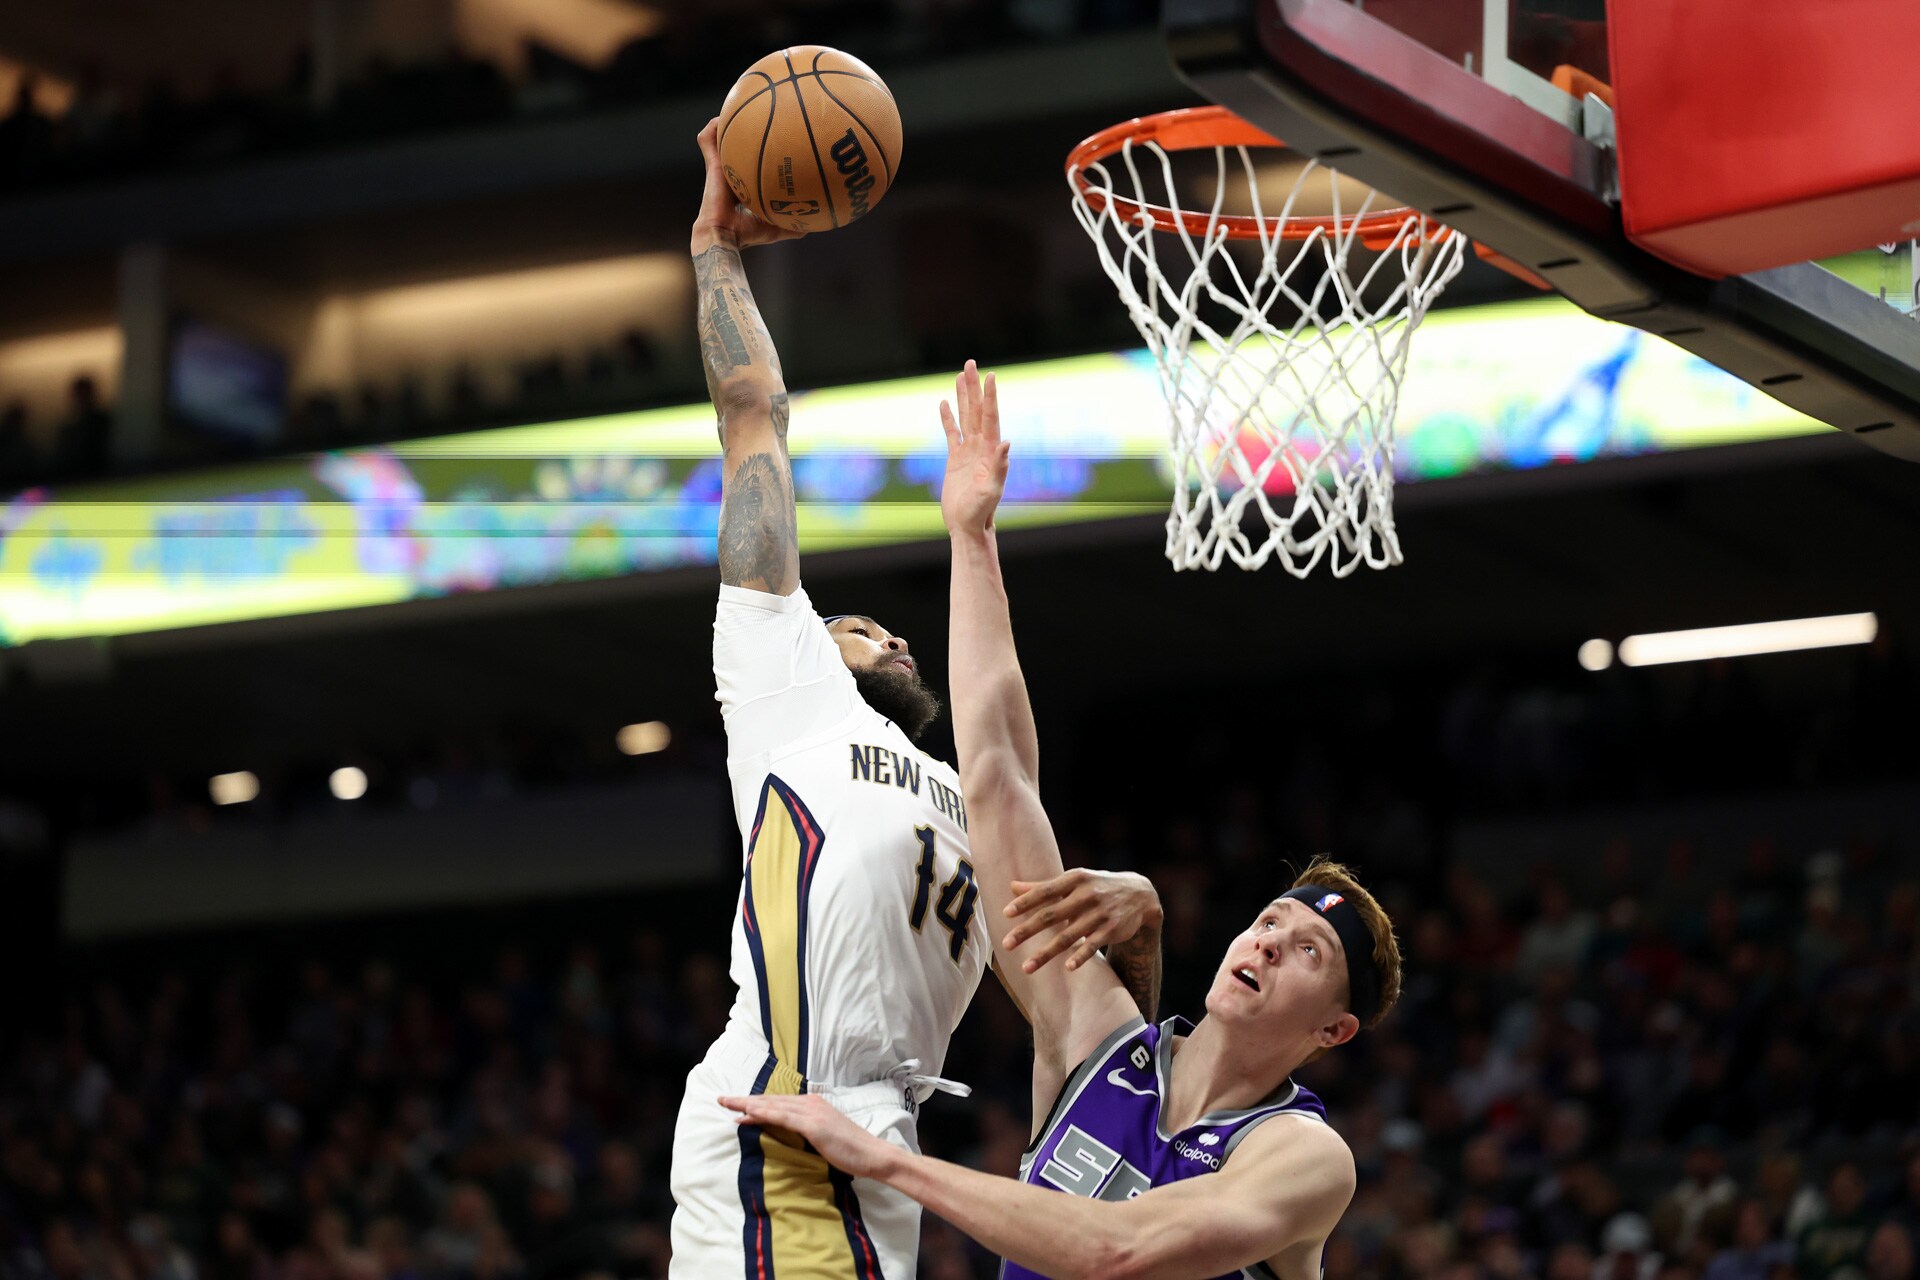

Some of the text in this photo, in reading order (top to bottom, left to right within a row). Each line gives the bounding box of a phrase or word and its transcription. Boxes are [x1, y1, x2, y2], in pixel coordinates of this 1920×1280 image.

[830, 128, 876, 222] Wilso
[850, 744, 921, 796] NEW
[910, 824, 979, 967] 14
[1130, 1045, 1150, 1069] 6
[1174, 1140, 1221, 1170] dialpad
